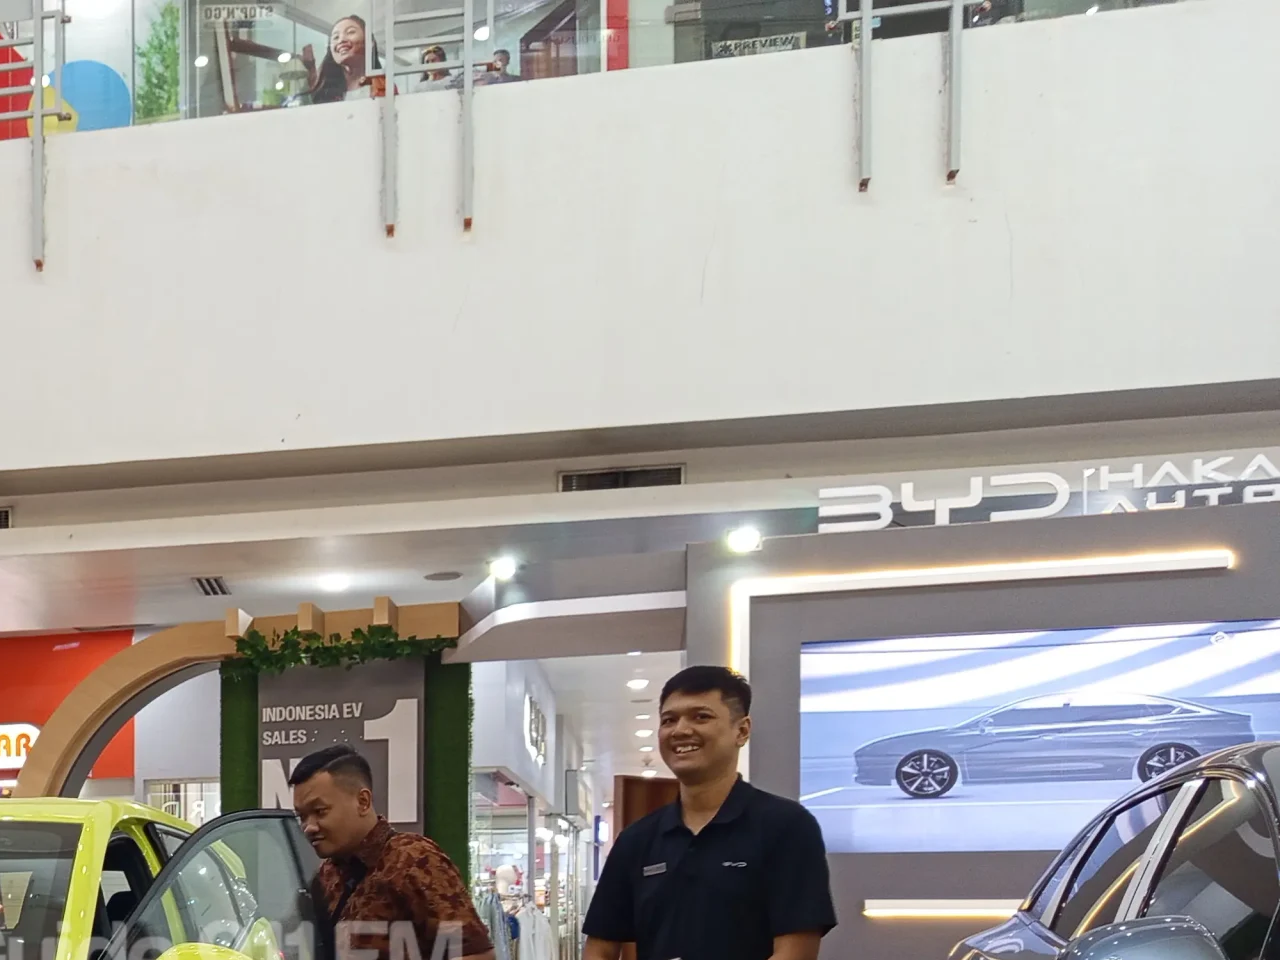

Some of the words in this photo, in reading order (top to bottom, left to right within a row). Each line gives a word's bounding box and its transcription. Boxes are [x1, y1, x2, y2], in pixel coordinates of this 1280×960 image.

[1099, 454, 1280, 490] HAKA
[818, 470, 1070, 533] BYD
[262, 704, 340, 722] INDONESIA
[343, 702, 363, 718] EV
[262, 729, 307, 745] SALES
[363, 698, 418, 824] 1
